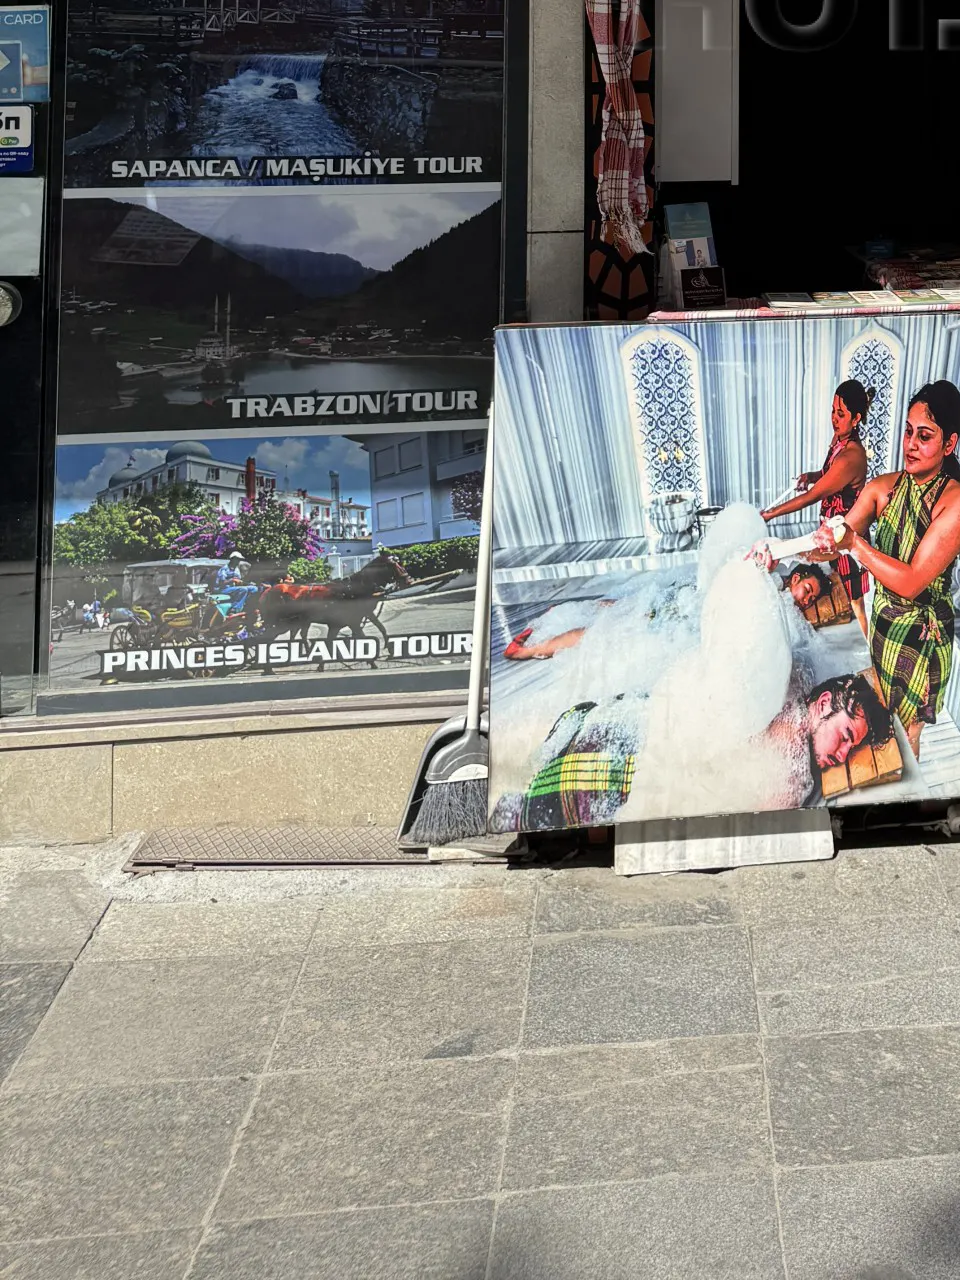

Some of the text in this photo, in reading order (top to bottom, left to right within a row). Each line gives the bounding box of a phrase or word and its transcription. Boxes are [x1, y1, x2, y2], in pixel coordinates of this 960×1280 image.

[4, 13, 44, 25] CARD
[111, 160, 242, 178] SAPANCA
[266, 151, 406, 182] MAŞUKİYE
[413, 156, 484, 174] TOUR
[226, 390, 478, 418] TRABZON TOUR
[103, 632, 473, 673] PRINCES ISLAND TOUR
